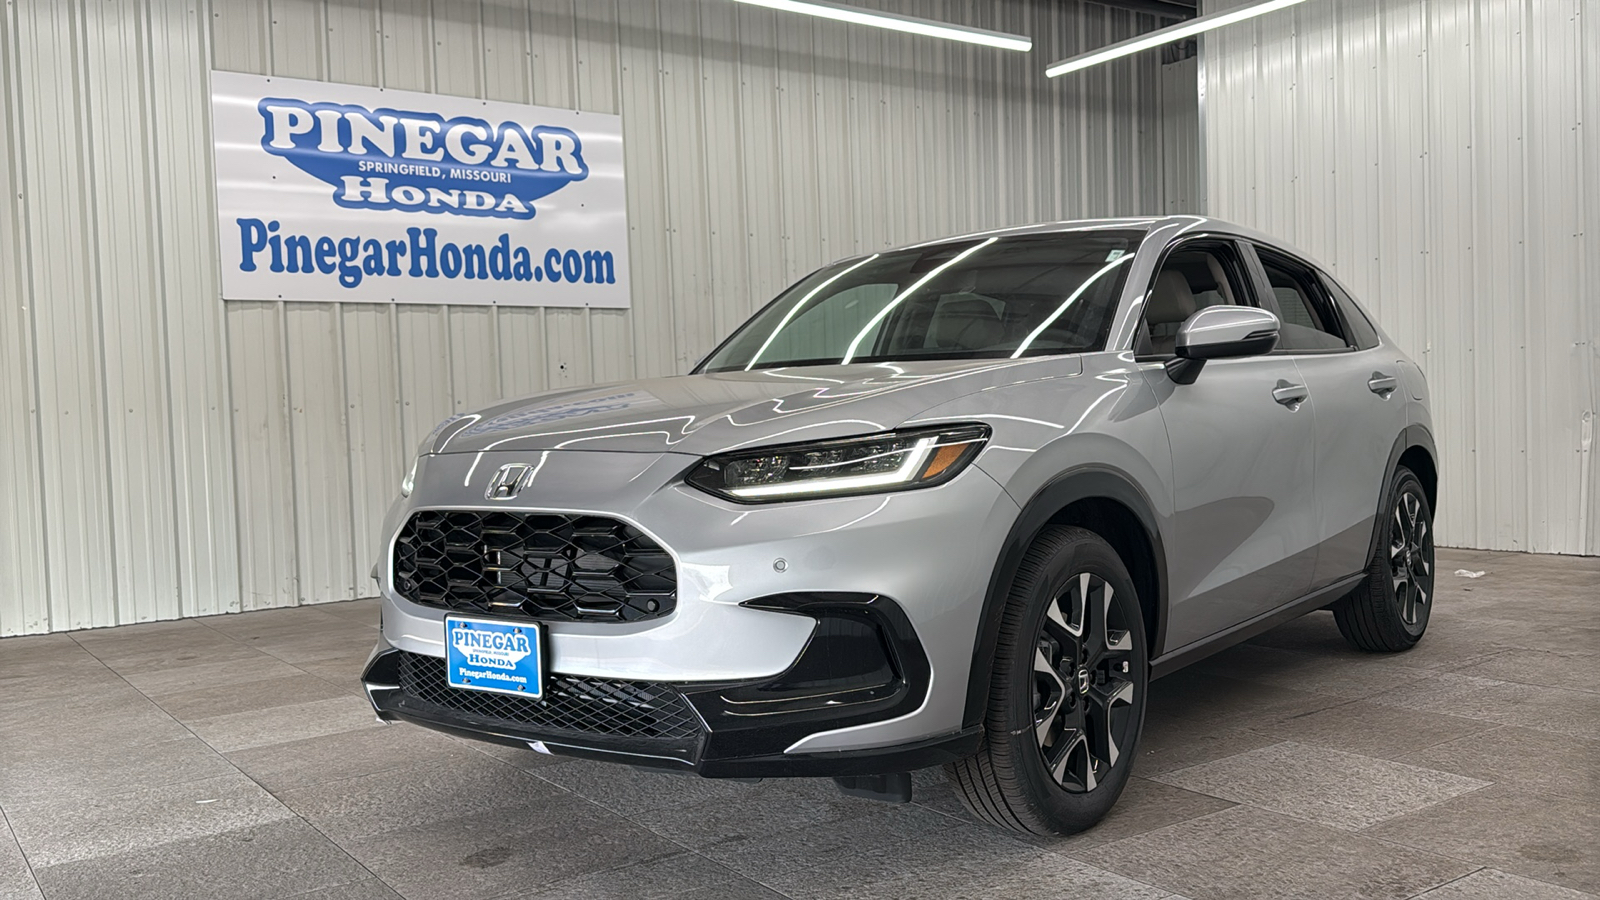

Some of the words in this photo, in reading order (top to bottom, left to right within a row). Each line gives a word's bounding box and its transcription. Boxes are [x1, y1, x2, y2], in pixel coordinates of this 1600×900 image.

[266, 105, 583, 175] PINEGAR
[358, 160, 447, 180] SPRINGFIELD,
[450, 168, 512, 184] MISSOURI
[236, 218, 616, 288] PinegarHonda.com
[454, 631, 528, 652] PINEGAR
[459, 667, 527, 683] PinegarHonda.com
